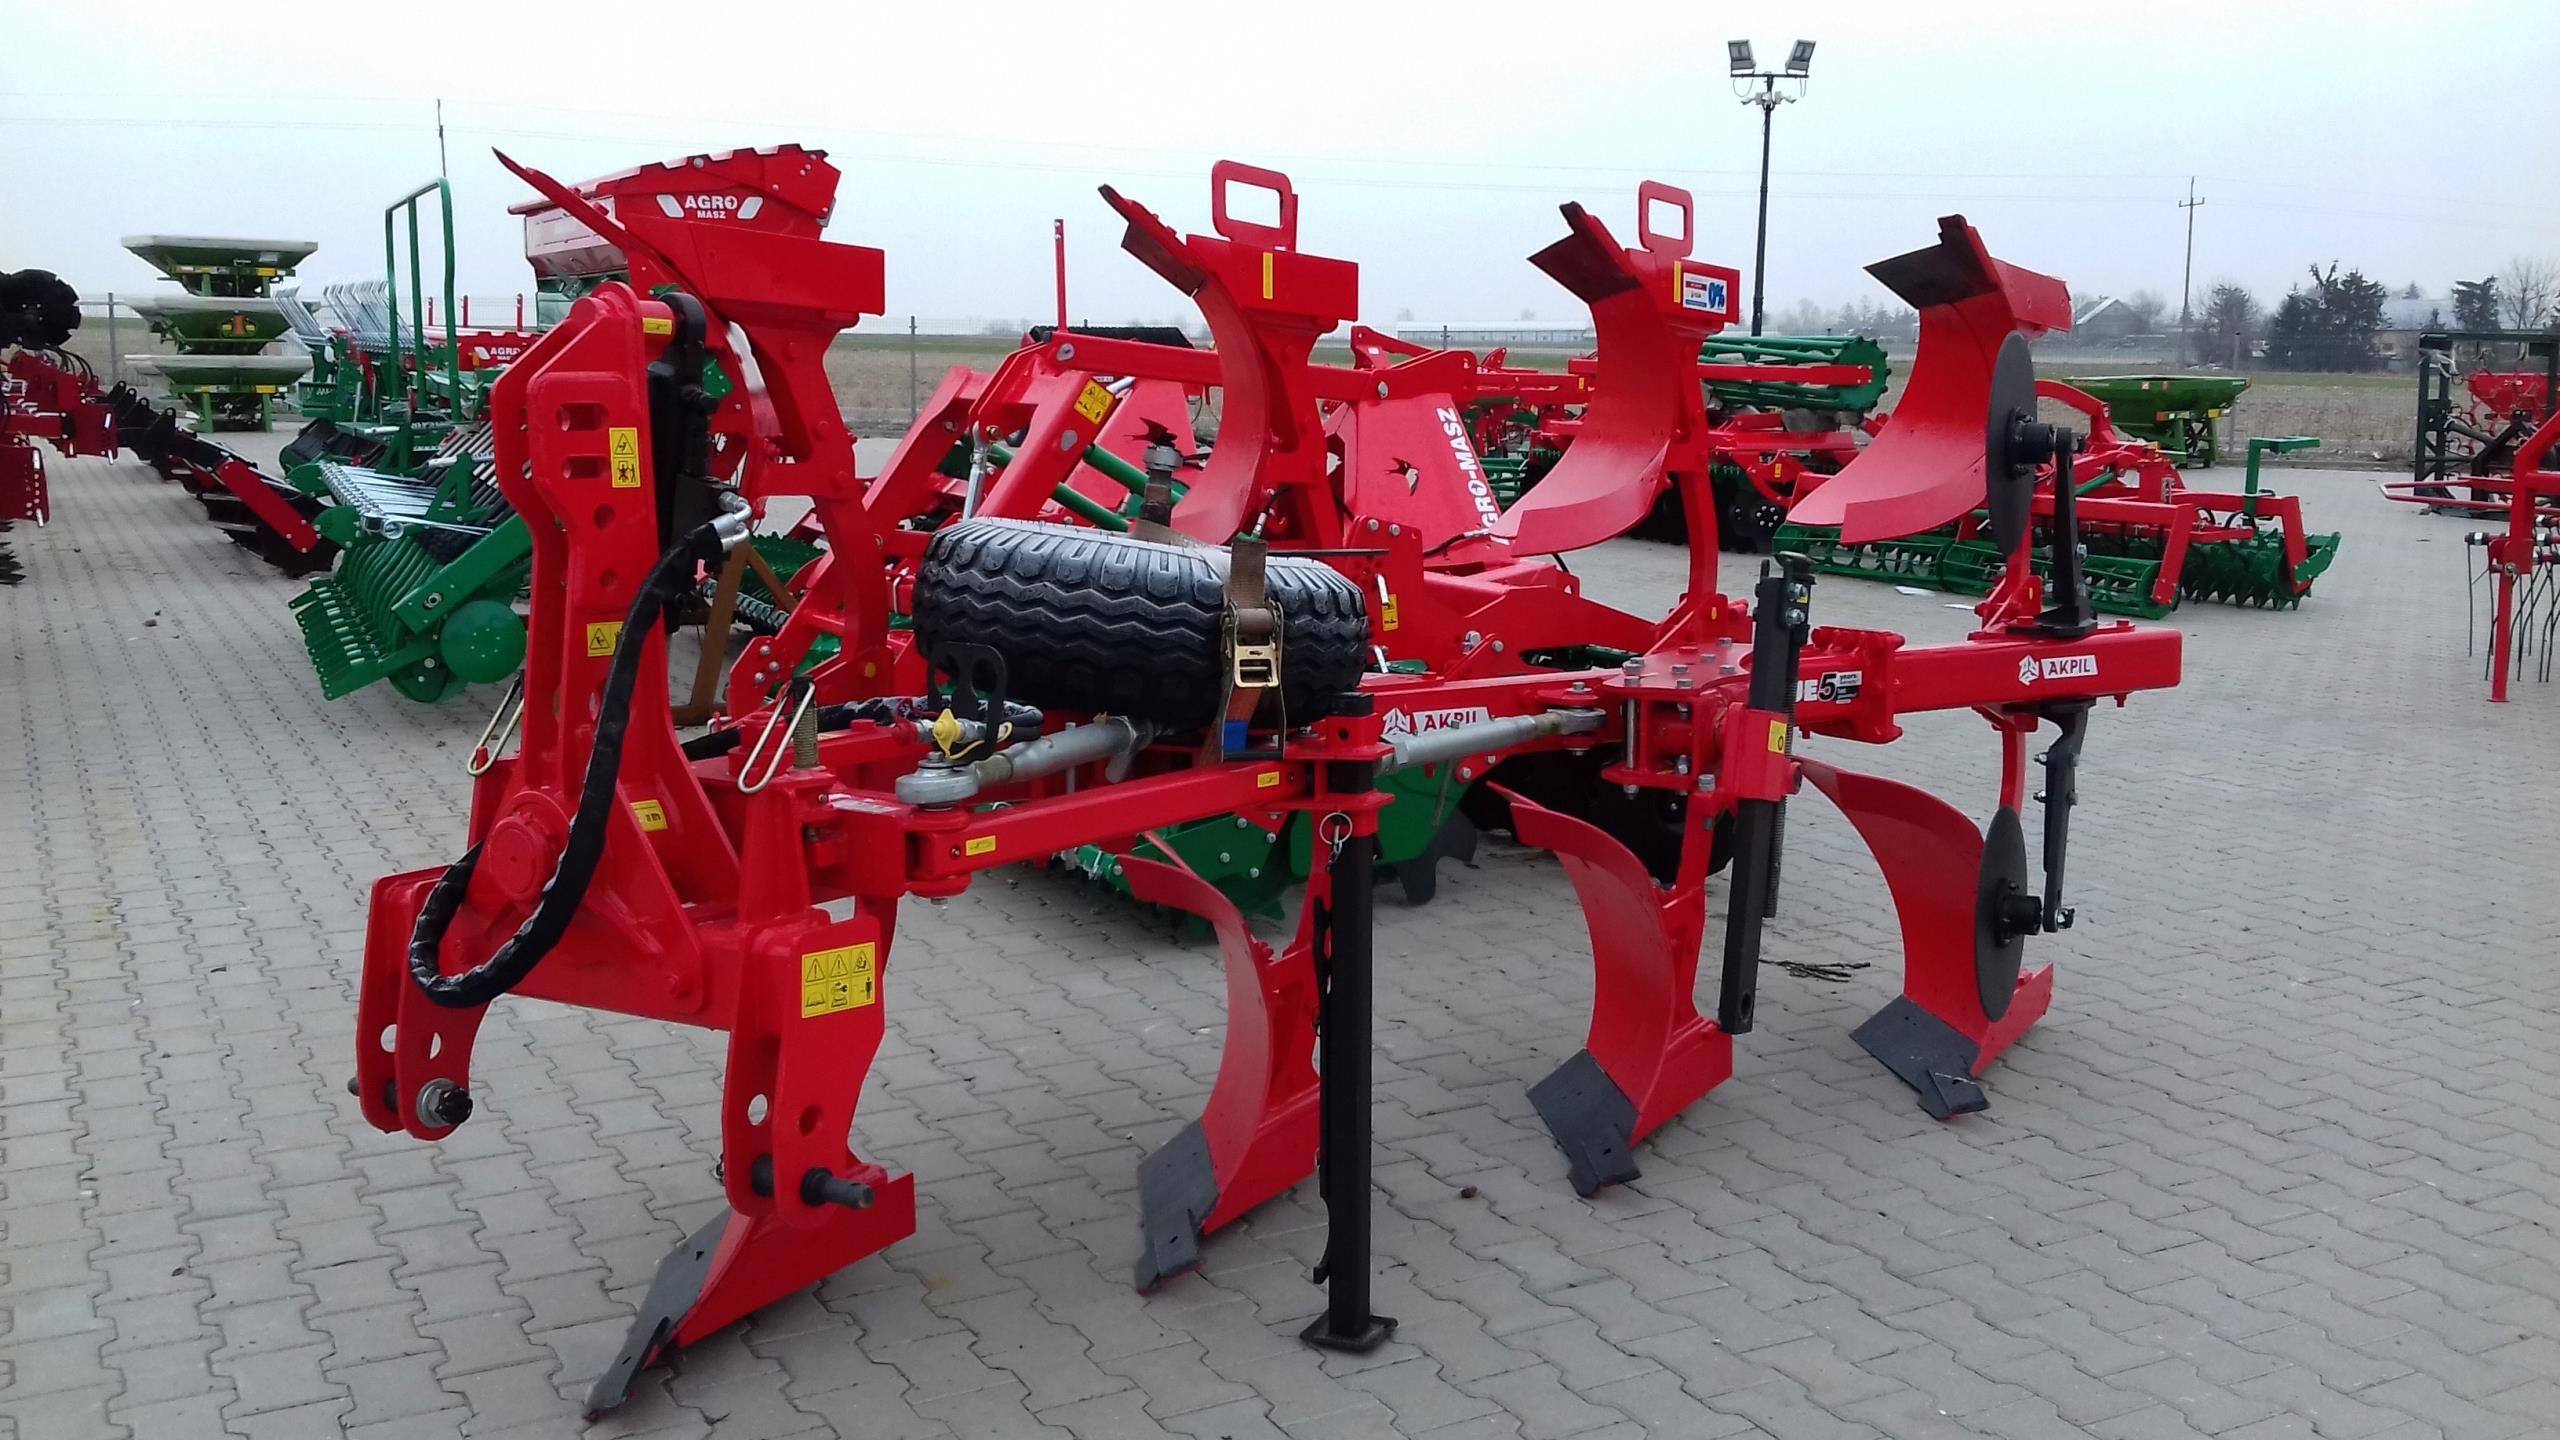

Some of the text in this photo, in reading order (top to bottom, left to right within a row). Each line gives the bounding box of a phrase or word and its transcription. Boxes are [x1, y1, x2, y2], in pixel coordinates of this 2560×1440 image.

[684, 195, 738, 210] AGRO
[697, 210, 727, 219] MASZ
[2048, 658, 2091, 676] AKPIL
